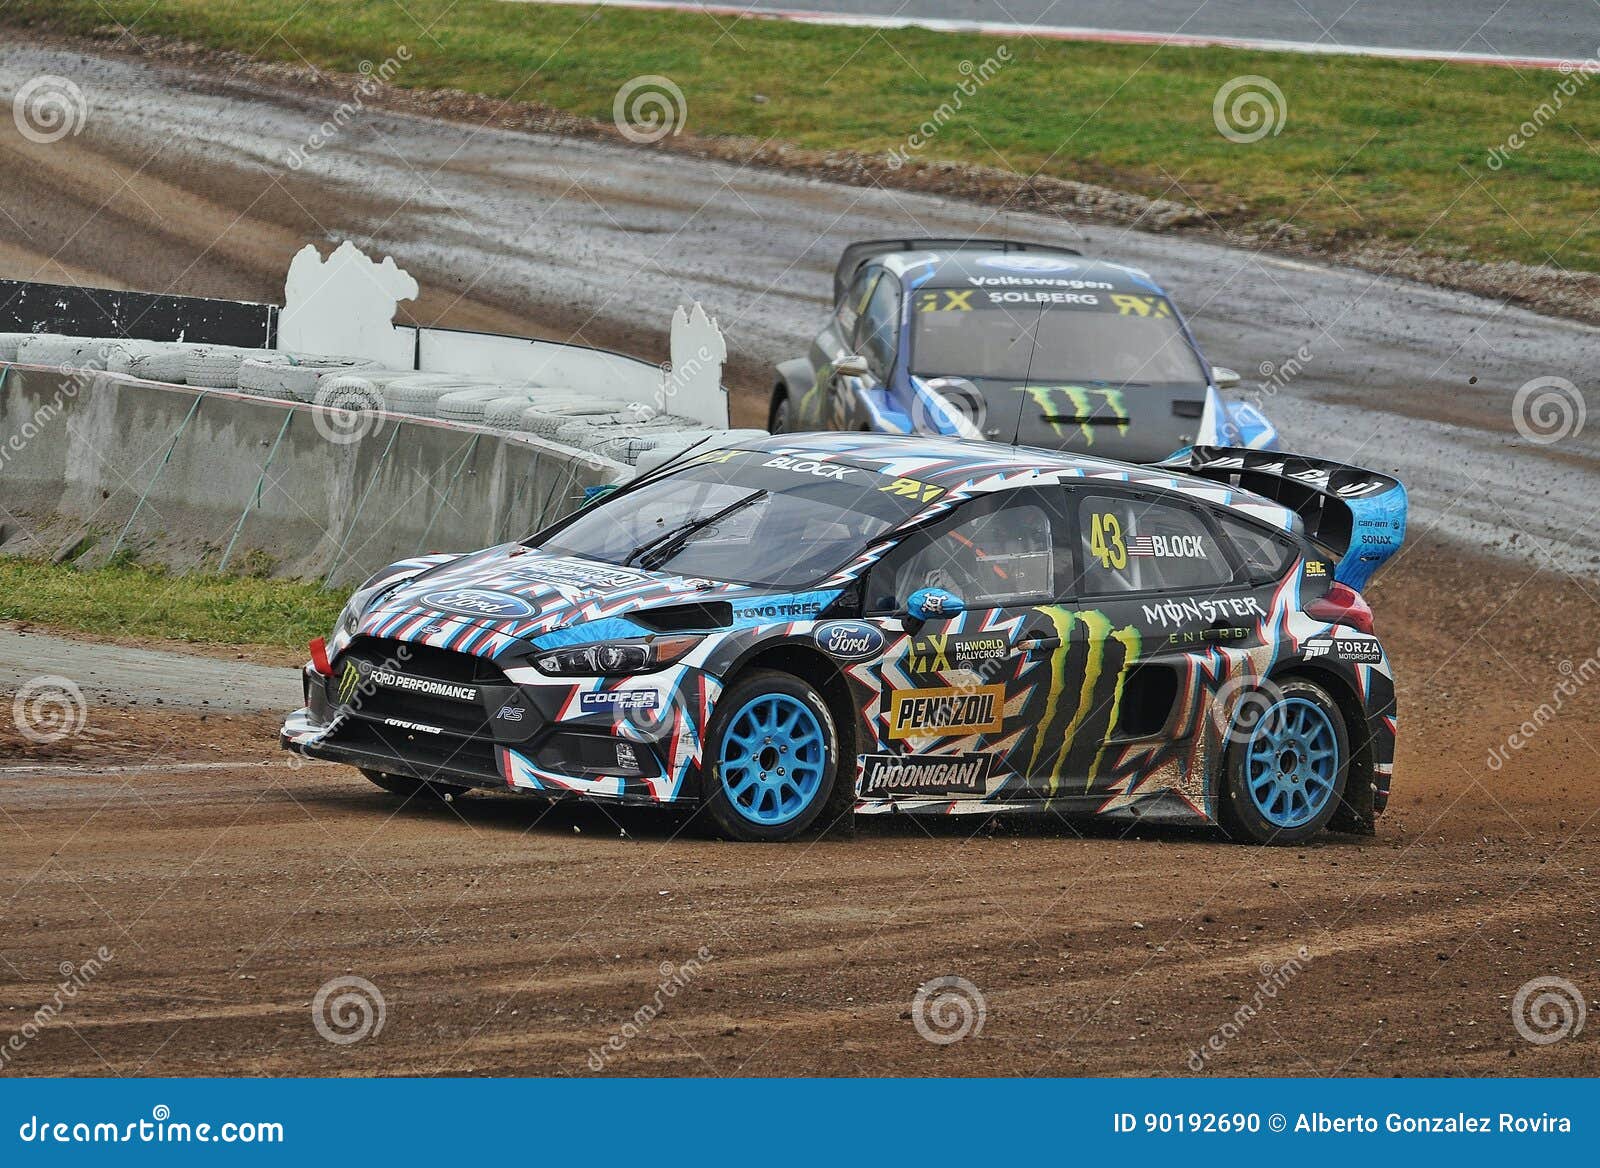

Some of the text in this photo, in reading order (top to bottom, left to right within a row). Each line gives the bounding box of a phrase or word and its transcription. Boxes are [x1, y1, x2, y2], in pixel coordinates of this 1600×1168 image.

[968, 276, 1113, 290] Volkswagen
[989, 291, 1099, 305] SOLBERG
[762, 456, 860, 481] BLOCK
[1091, 513, 1207, 570] 43 BLOCK
[1361, 535, 1392, 545] SONAX
[778, 602, 821, 616] TIRES
[828, 626, 869, 652] Ford
[955, 648, 1004, 661] RALLYCROSS
[1337, 641, 1380, 654] FORZA
[1339, 653, 1380, 661] MOTORSPORT
[369, 670, 476, 701] FORD PERFORMANCE
[583, 691, 656, 703] COOPER
[618, 700, 654, 709] TIRES
[497, 706, 525, 721] RS
[896, 693, 996, 731] PENNZOIL
